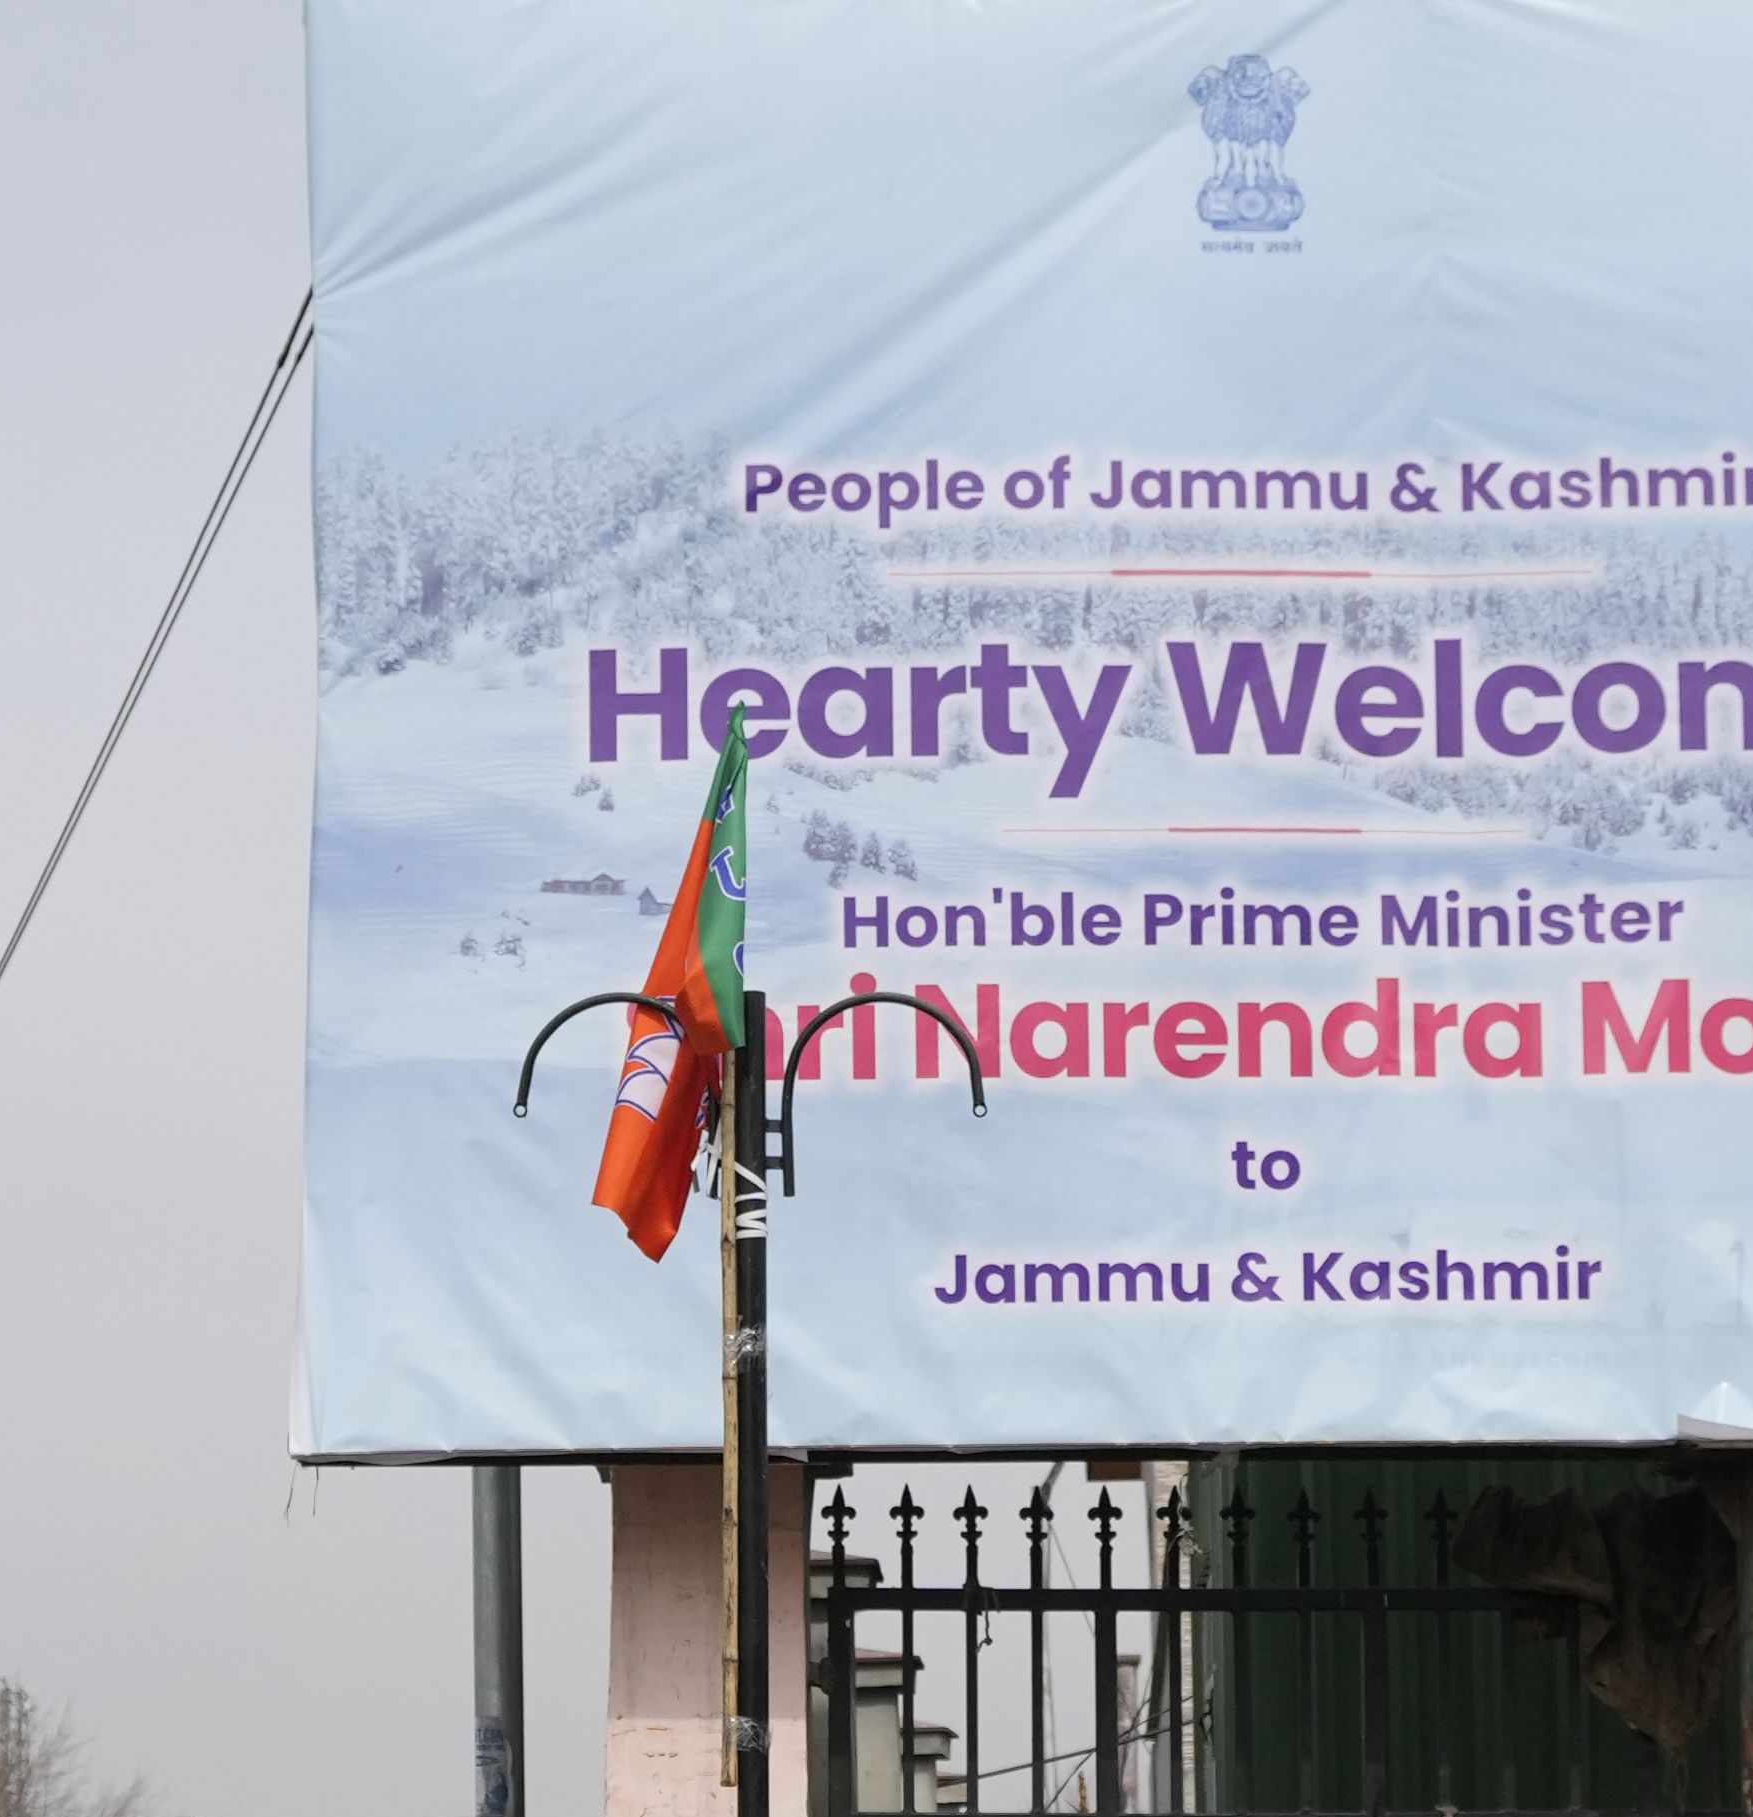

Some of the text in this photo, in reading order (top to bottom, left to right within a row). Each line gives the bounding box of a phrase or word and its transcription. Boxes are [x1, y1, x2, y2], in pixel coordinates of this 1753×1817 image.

[744, 460, 984, 529] People
[1003, 455, 1070, 510] of
[1088, 461, 1369, 512] Jammu
[1389, 463, 1438, 513] &
[588, 642, 1132, 799] Hearty
[843, 887, 1684, 949] Hon'ble Prime Minister
[914, 977, 1545, 1081] Narendra
[1230, 1140, 1302, 1191] to
[934, 1244, 1602, 1304] Jammu & Kashmir
